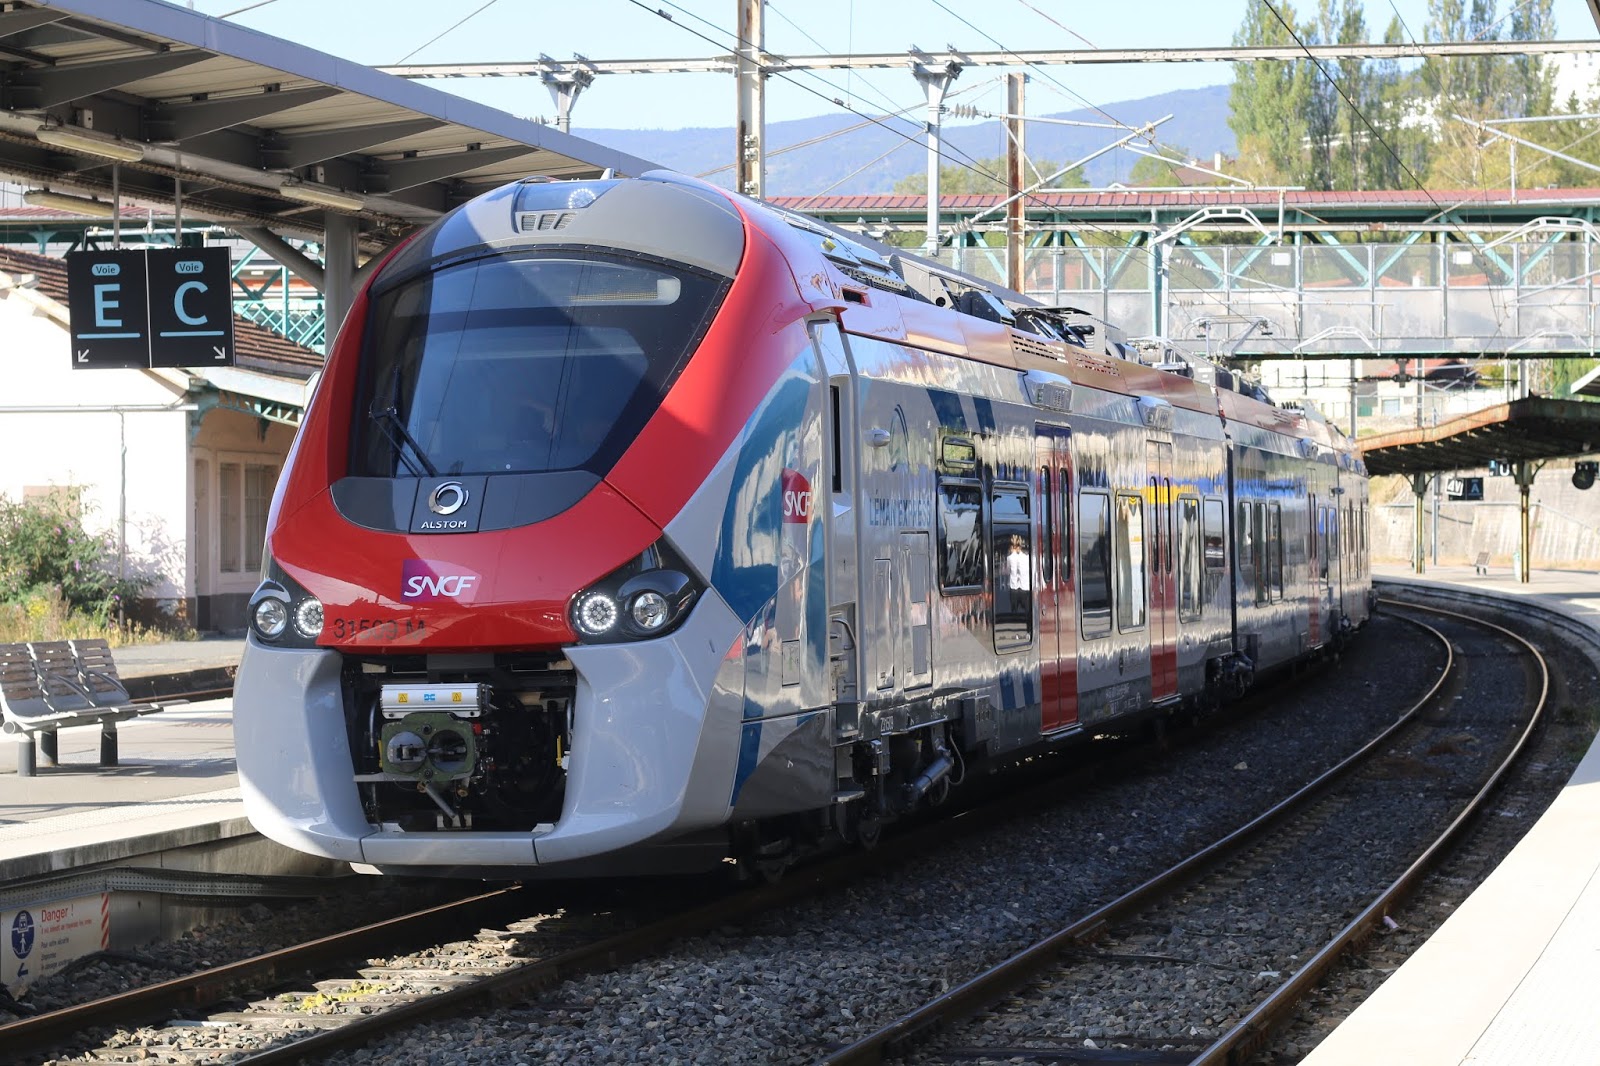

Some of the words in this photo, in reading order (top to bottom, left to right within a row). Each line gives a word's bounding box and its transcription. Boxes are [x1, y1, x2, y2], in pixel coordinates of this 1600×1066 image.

[96, 266, 116, 274] Voie
[179, 263, 199, 272] Voie
[94, 284, 122, 327] E
[174, 281, 208, 325] C
[1471, 484, 1479, 493] A
[784, 491, 812, 516] SNCF
[421, 520, 467, 529] ALSTOM
[404, 575, 476, 597] SNCF
[406, 619, 426, 640] M
[42, 908, 68, 922] Danger
